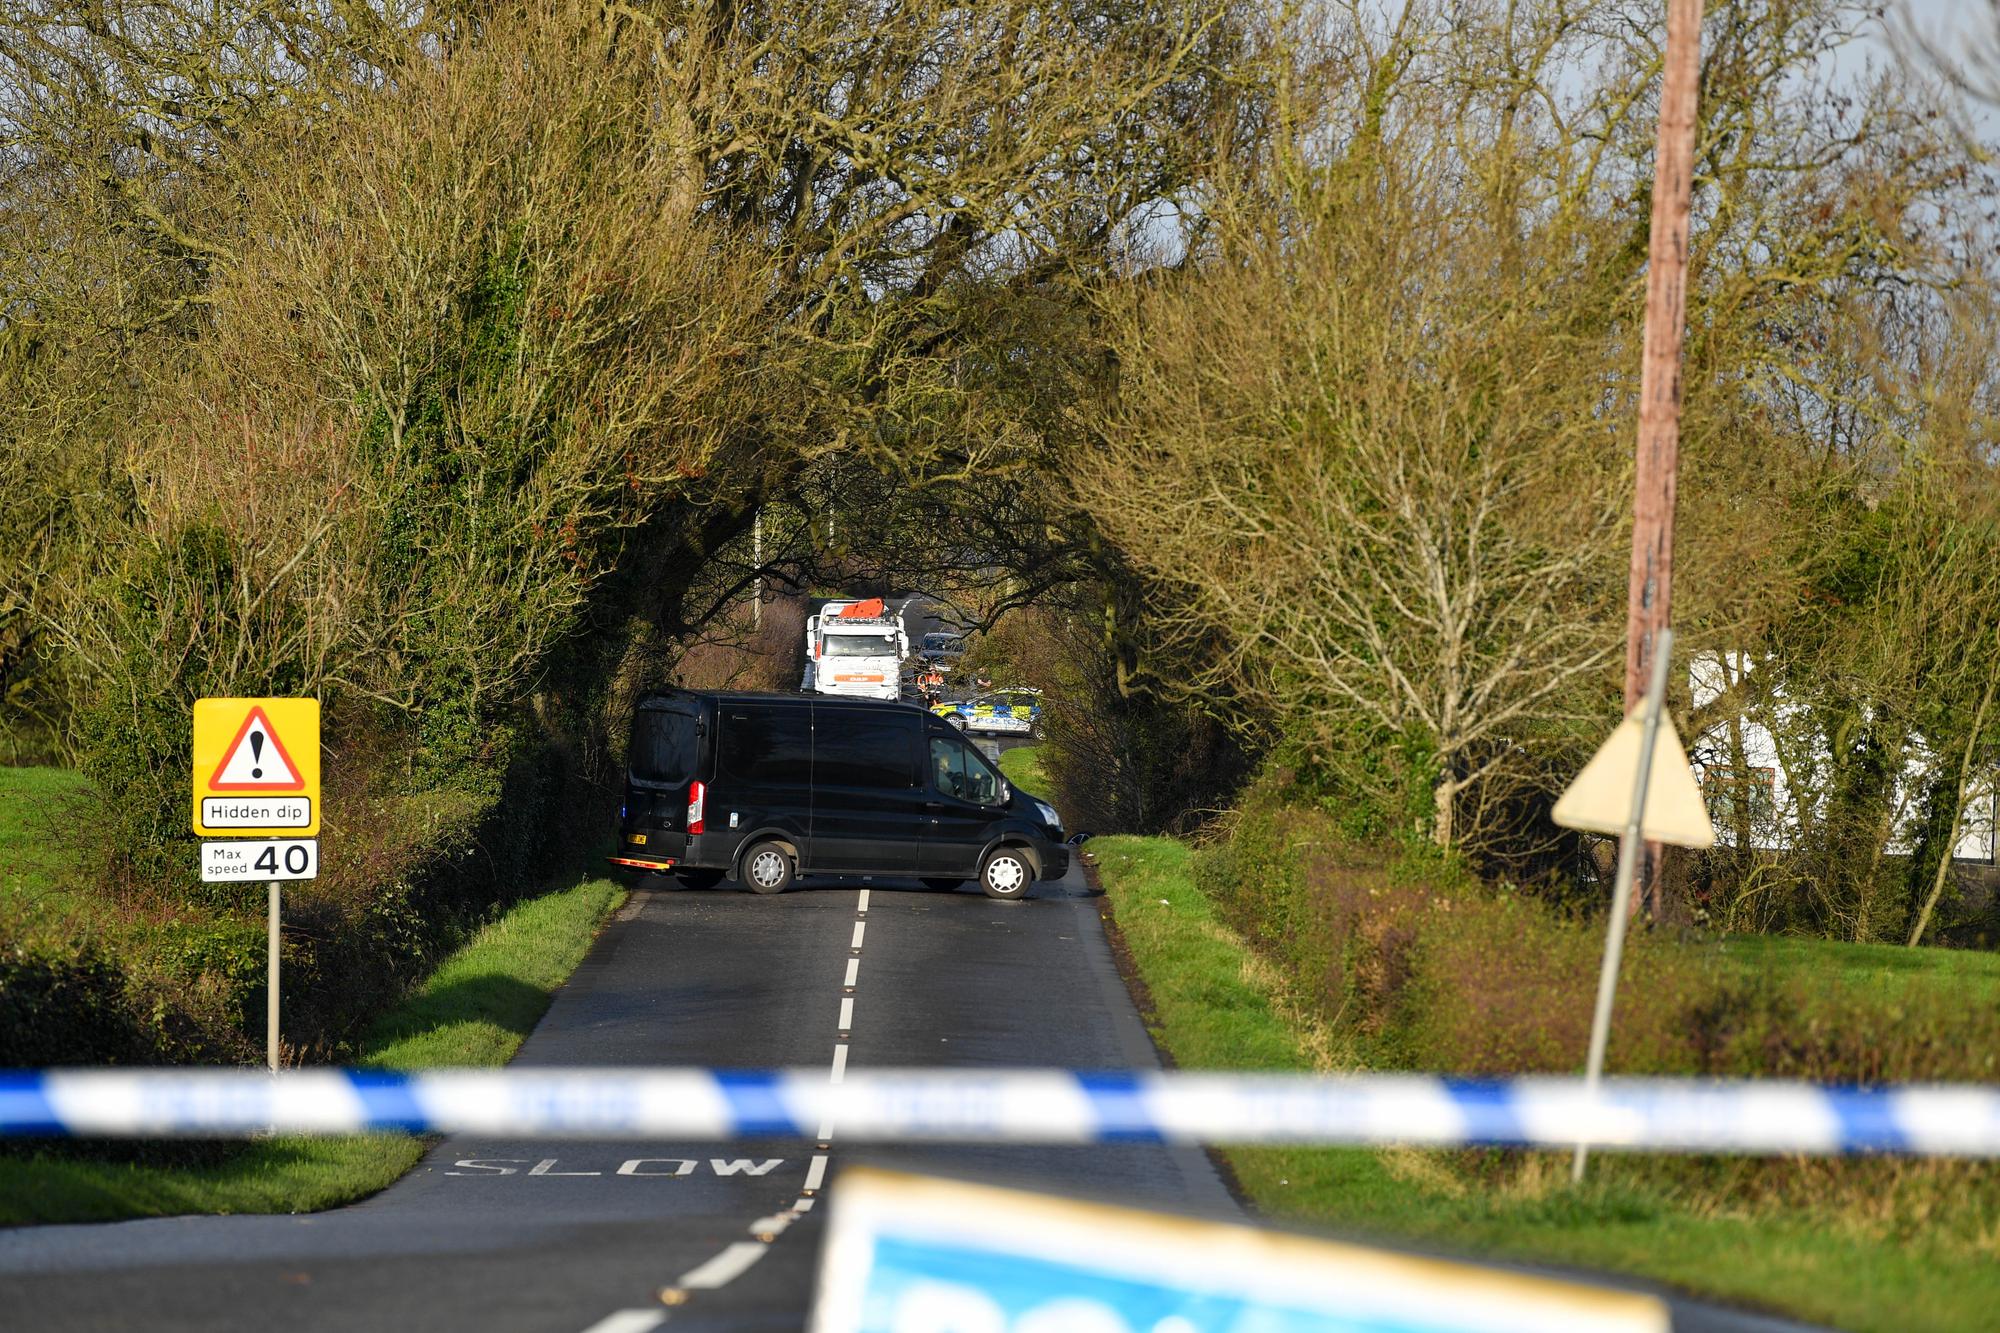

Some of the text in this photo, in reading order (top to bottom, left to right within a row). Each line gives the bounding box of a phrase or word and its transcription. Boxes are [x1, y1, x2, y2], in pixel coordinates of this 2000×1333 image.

[211, 805, 302, 820] Hidden dip
[213, 849, 241, 860] Max
[254, 845, 309, 875] 40
[207, 863, 247, 876] speed
[444, 1158, 785, 1177] SLOW
